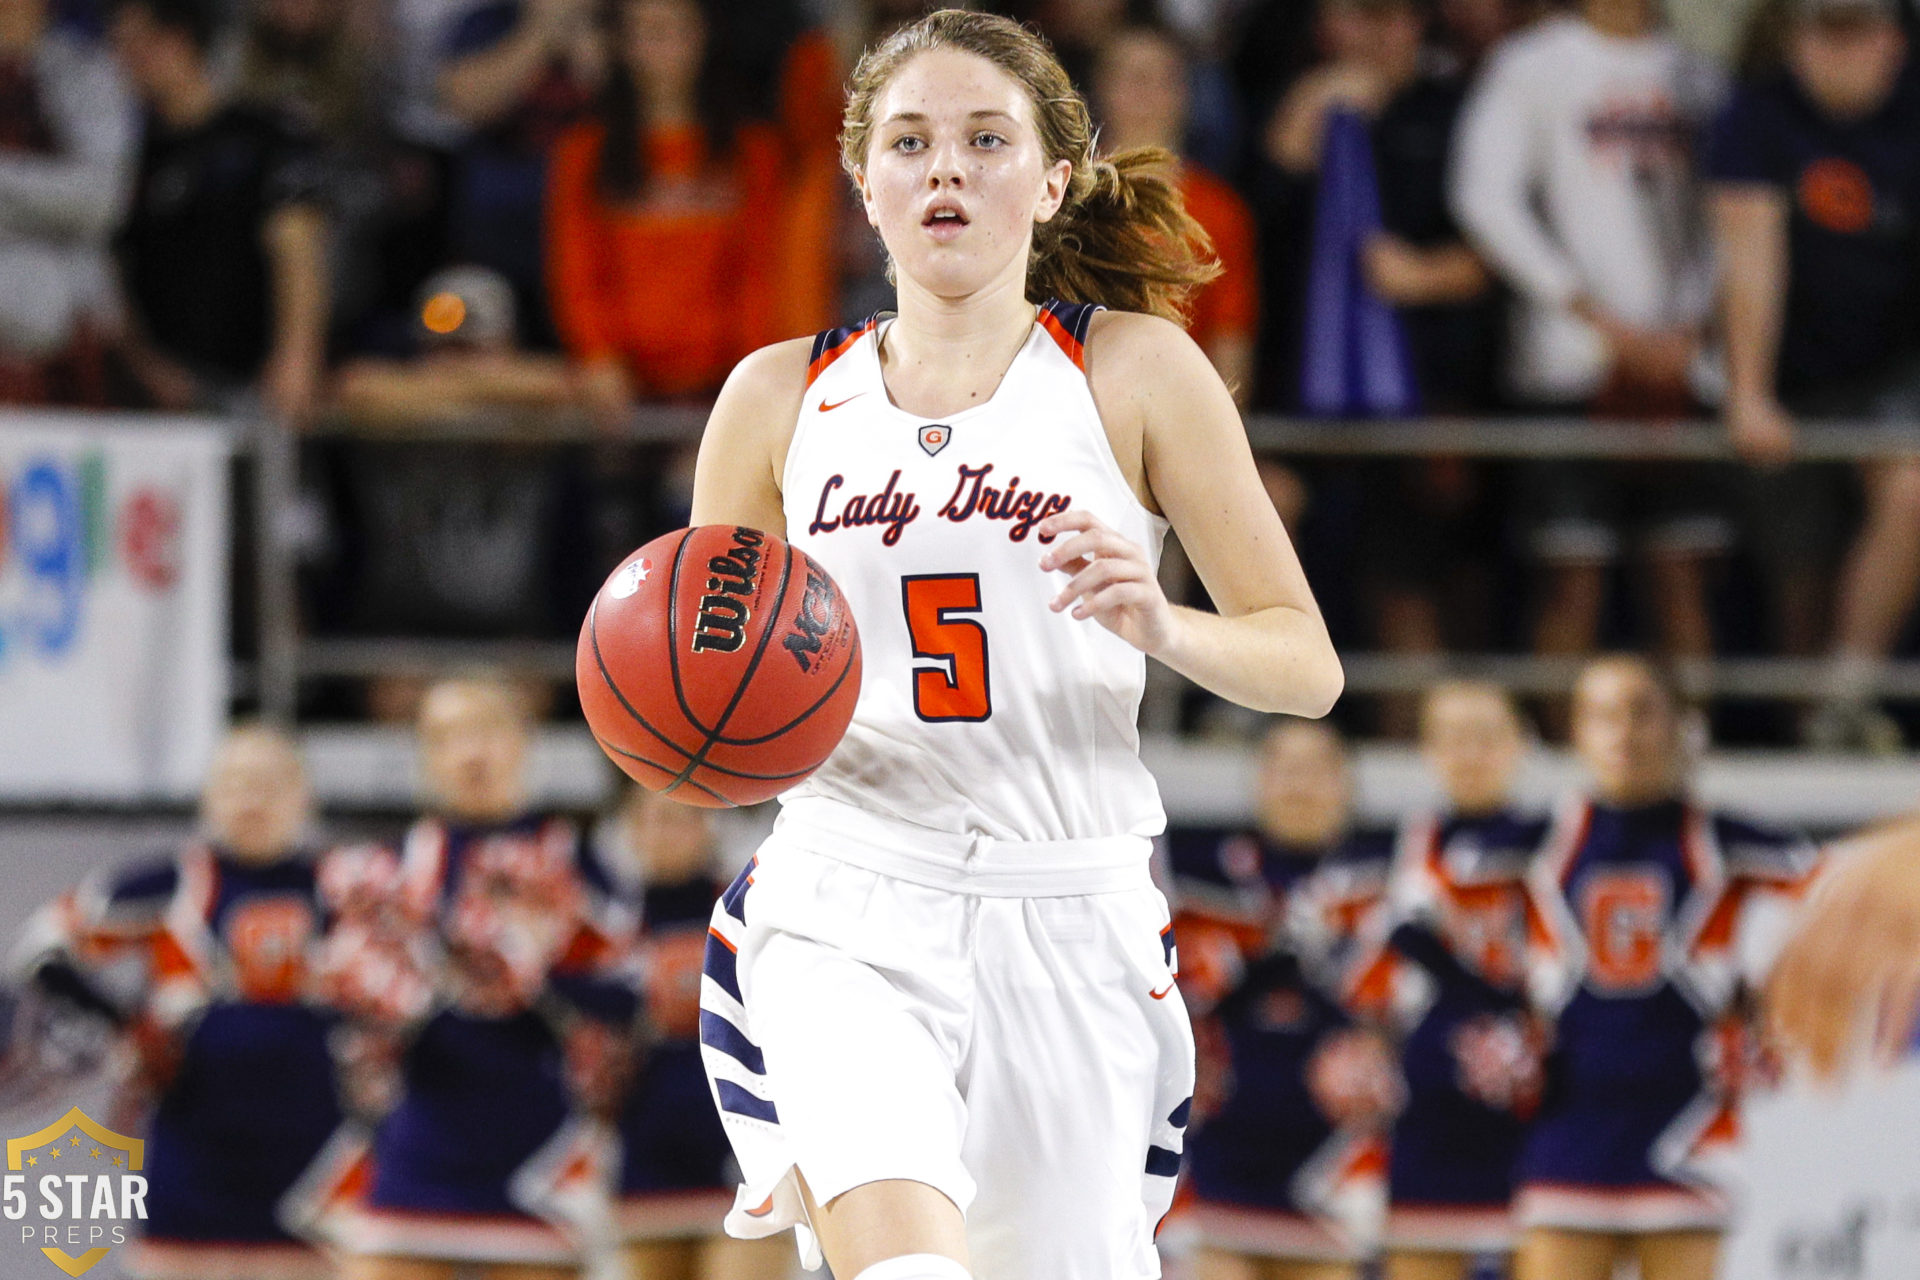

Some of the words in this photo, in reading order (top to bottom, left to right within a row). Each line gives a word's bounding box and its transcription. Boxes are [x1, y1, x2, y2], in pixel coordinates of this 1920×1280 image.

[925, 431, 942, 444] G
[0, 452, 184, 662] gle
[809, 469, 920, 547] Lady
[901, 572, 992, 723] 5
